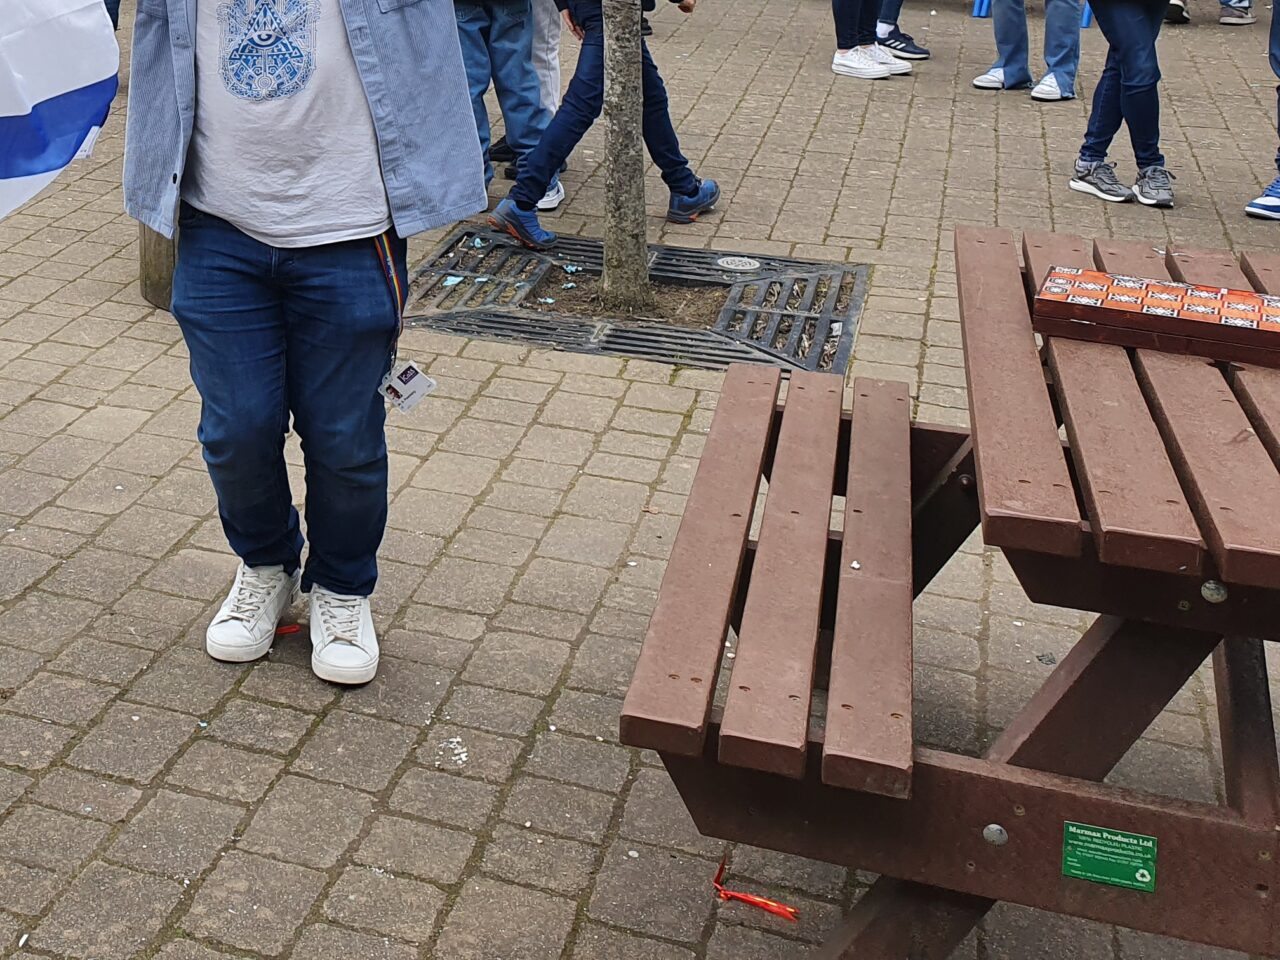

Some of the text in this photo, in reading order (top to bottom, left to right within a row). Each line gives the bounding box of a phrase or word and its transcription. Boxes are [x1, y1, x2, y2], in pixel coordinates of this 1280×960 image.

[1068, 825, 1153, 847] Marmax Products Ltd
